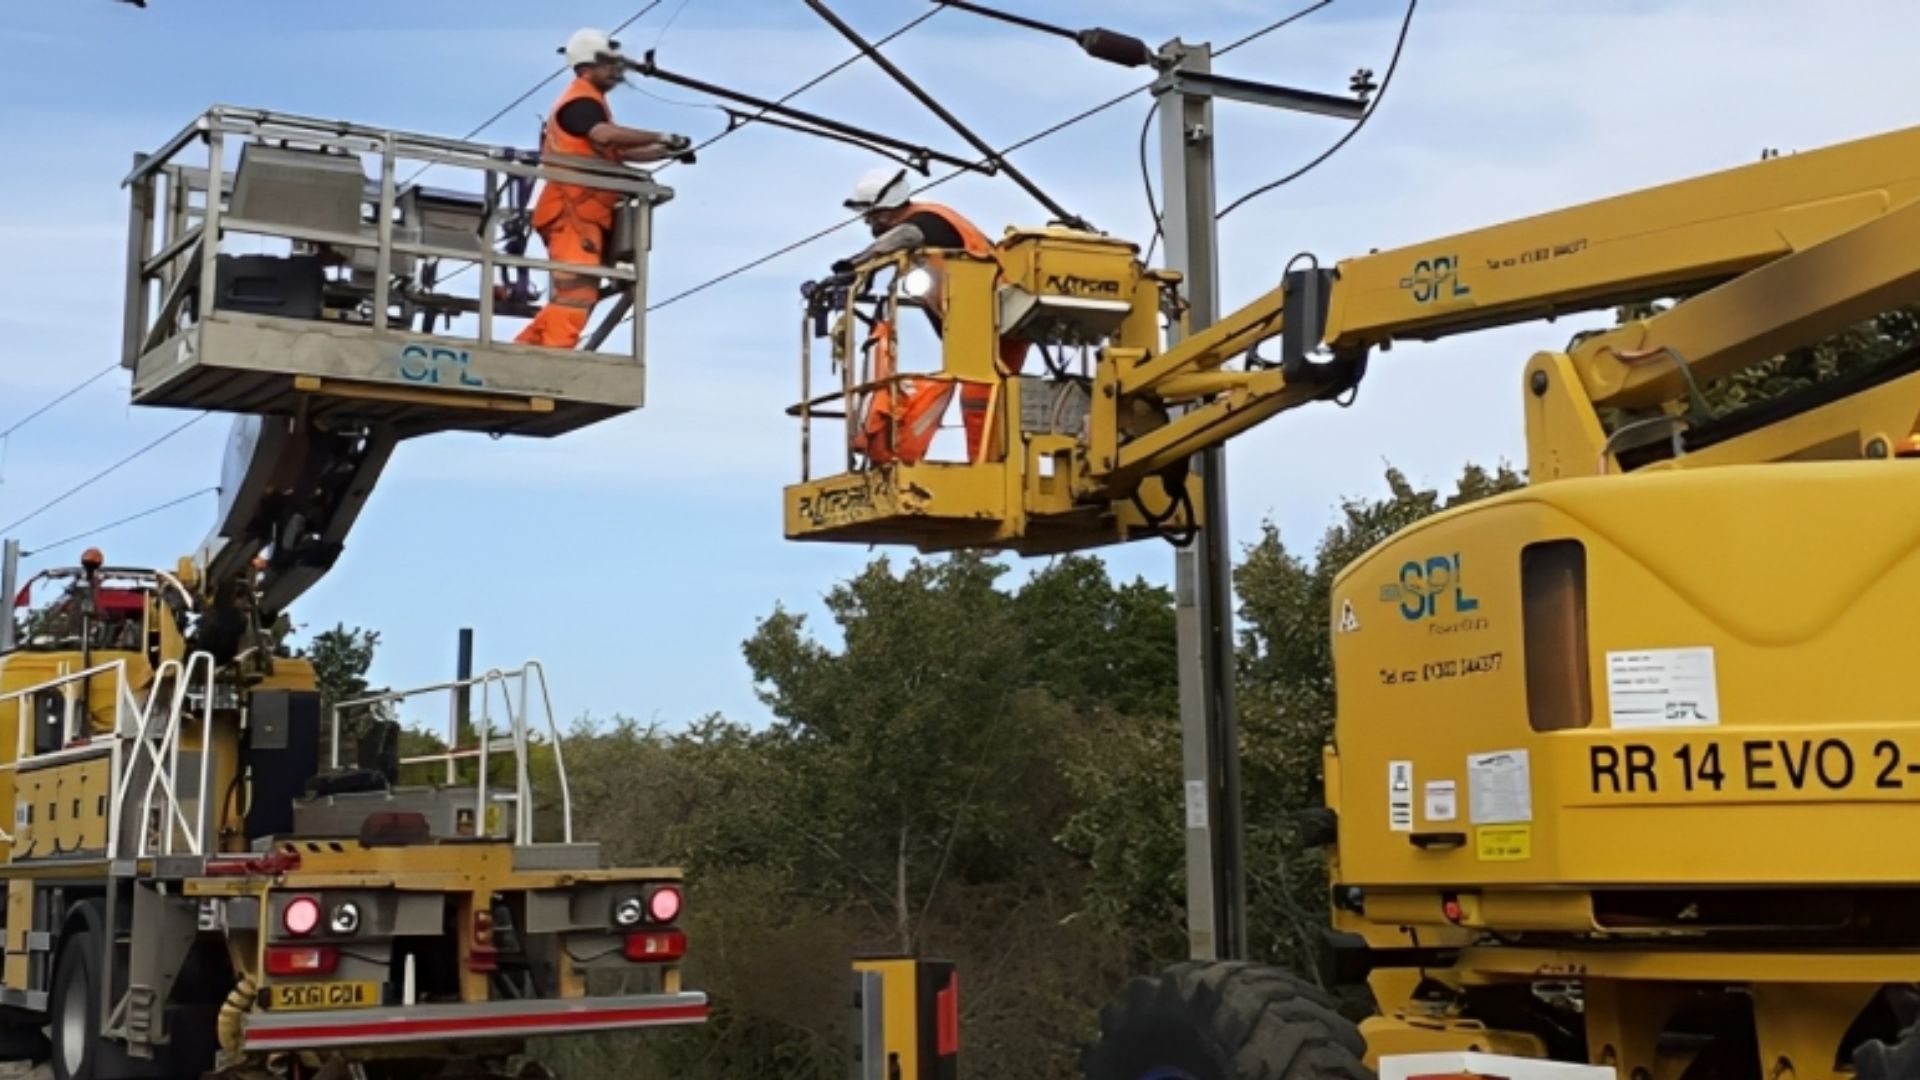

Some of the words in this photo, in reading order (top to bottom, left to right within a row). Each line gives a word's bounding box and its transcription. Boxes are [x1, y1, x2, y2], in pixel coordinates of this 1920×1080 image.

[1413, 255, 1470, 302] SPL
[1399, 551, 1479, 621] SPL
[1590, 745, 1658, 793] RR
[1674, 742, 1726, 791] 14
[1742, 738, 1855, 790] EVO
